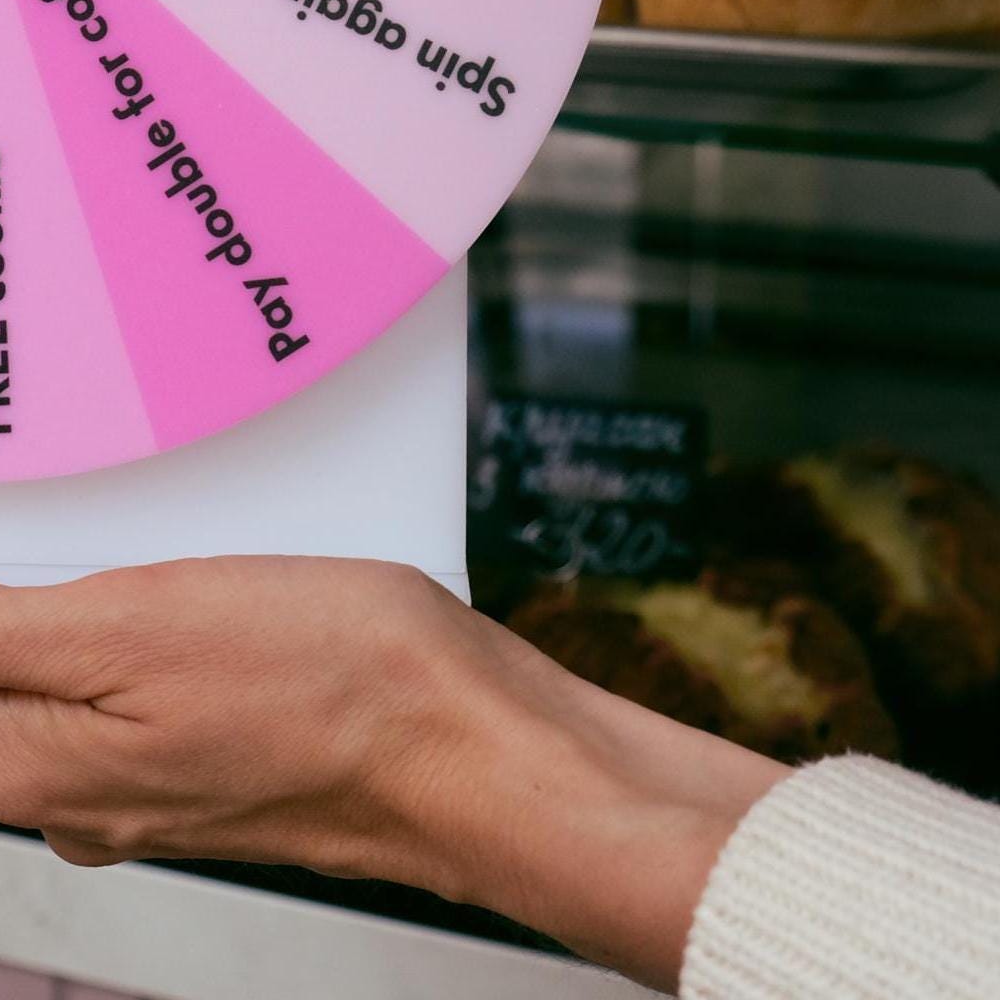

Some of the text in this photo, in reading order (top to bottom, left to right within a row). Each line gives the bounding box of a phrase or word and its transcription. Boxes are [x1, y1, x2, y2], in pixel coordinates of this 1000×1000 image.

[99, 54, 154, 120] for
[417, 39, 515, 117] Spin
[147, 120, 252, 265] double
[244, 278, 309, 361] Pay
